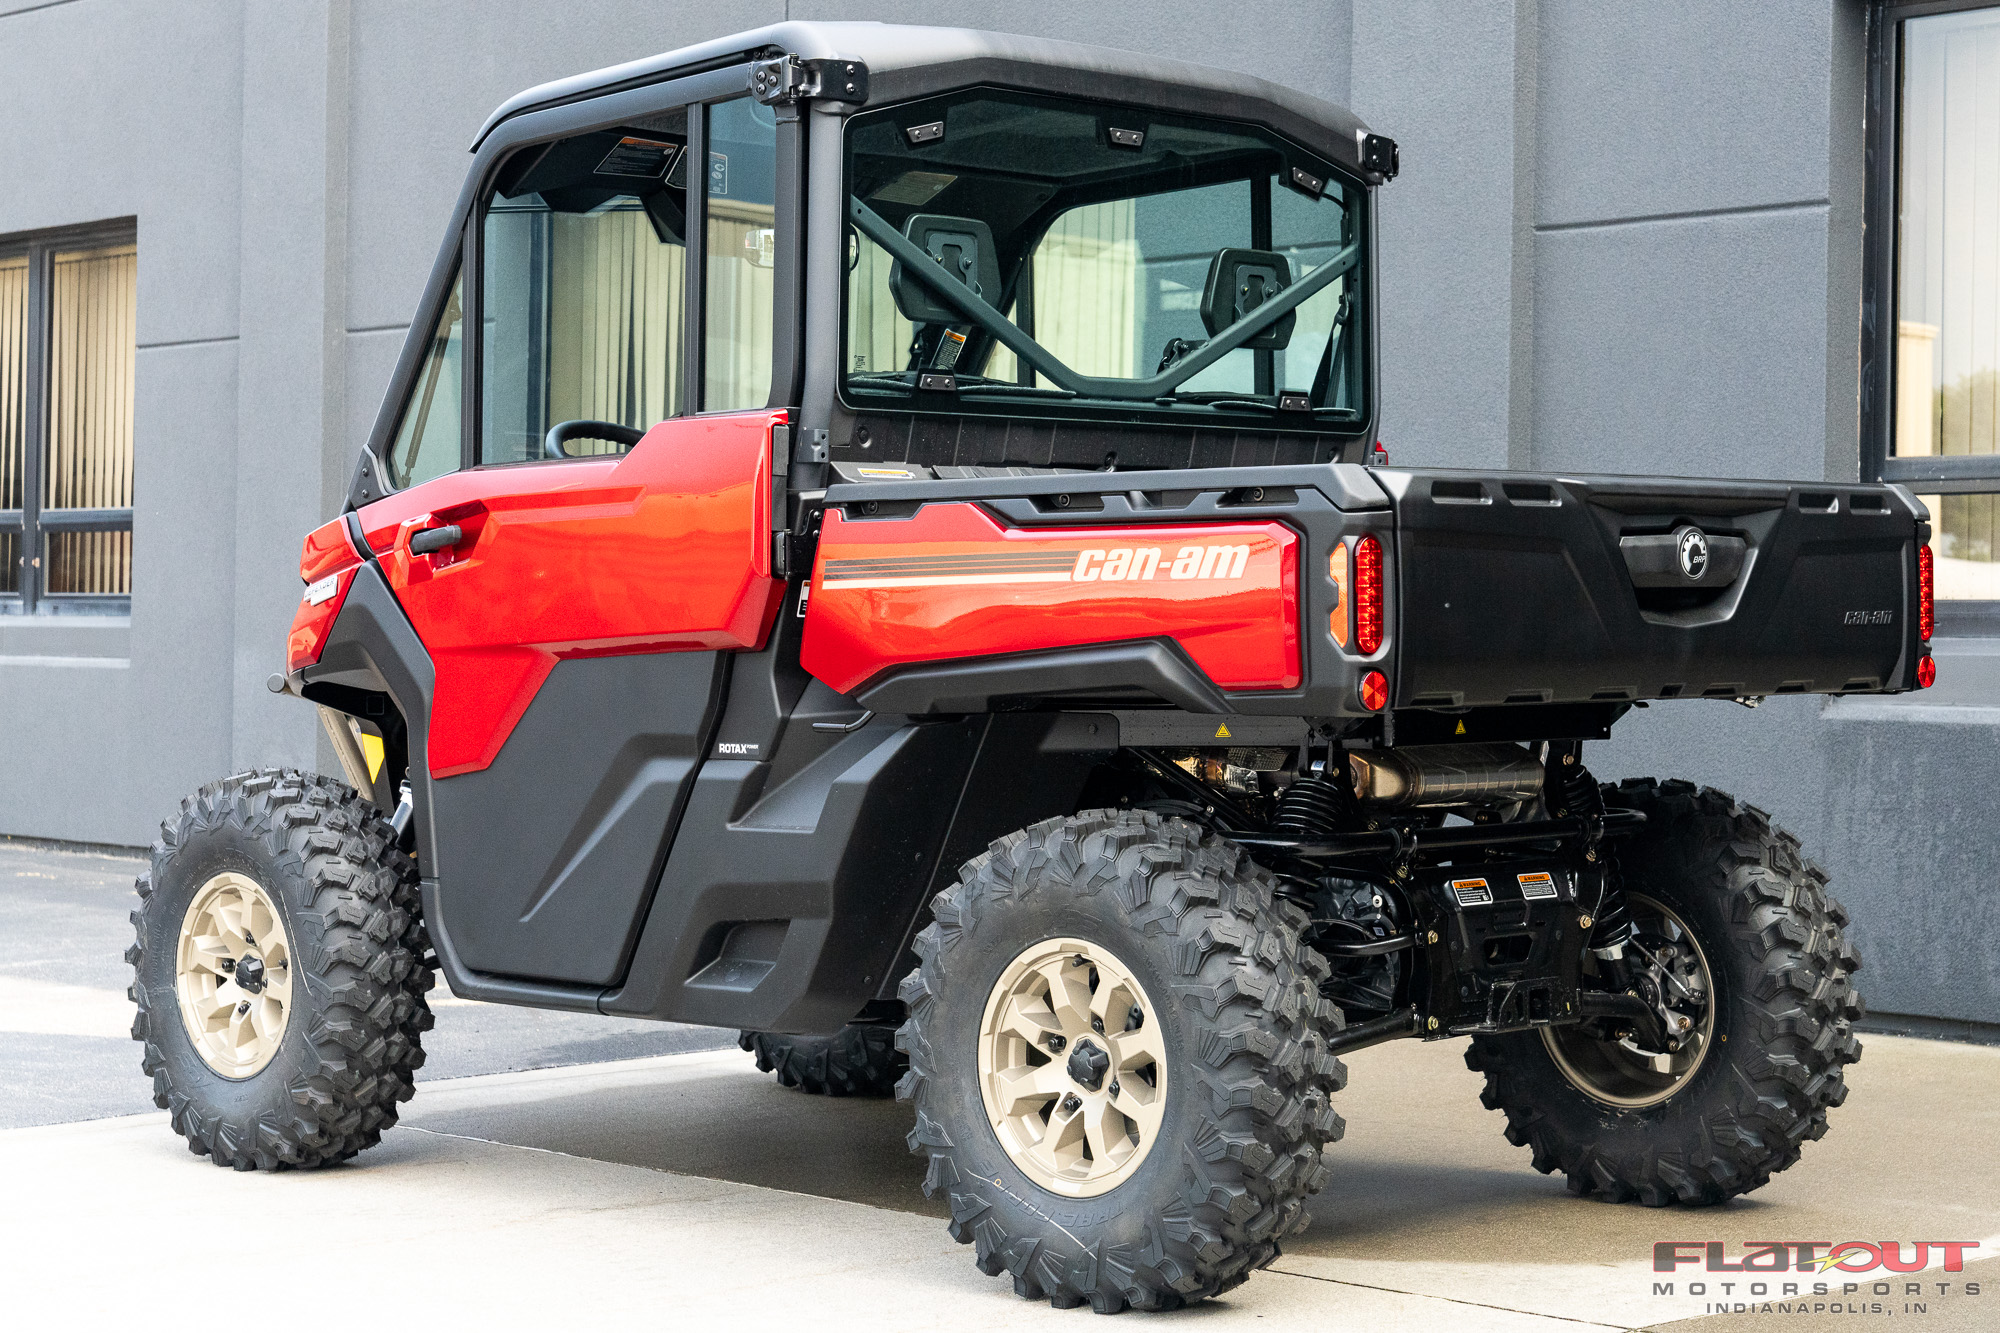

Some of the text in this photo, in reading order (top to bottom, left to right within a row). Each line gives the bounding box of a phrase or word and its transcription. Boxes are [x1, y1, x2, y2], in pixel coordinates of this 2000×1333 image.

[1072, 544, 1250, 582] can-am
[1692, 555, 1706, 564] BRP
[1844, 610, 1893, 625] can-am
[718, 743, 747, 754] ROTAX
